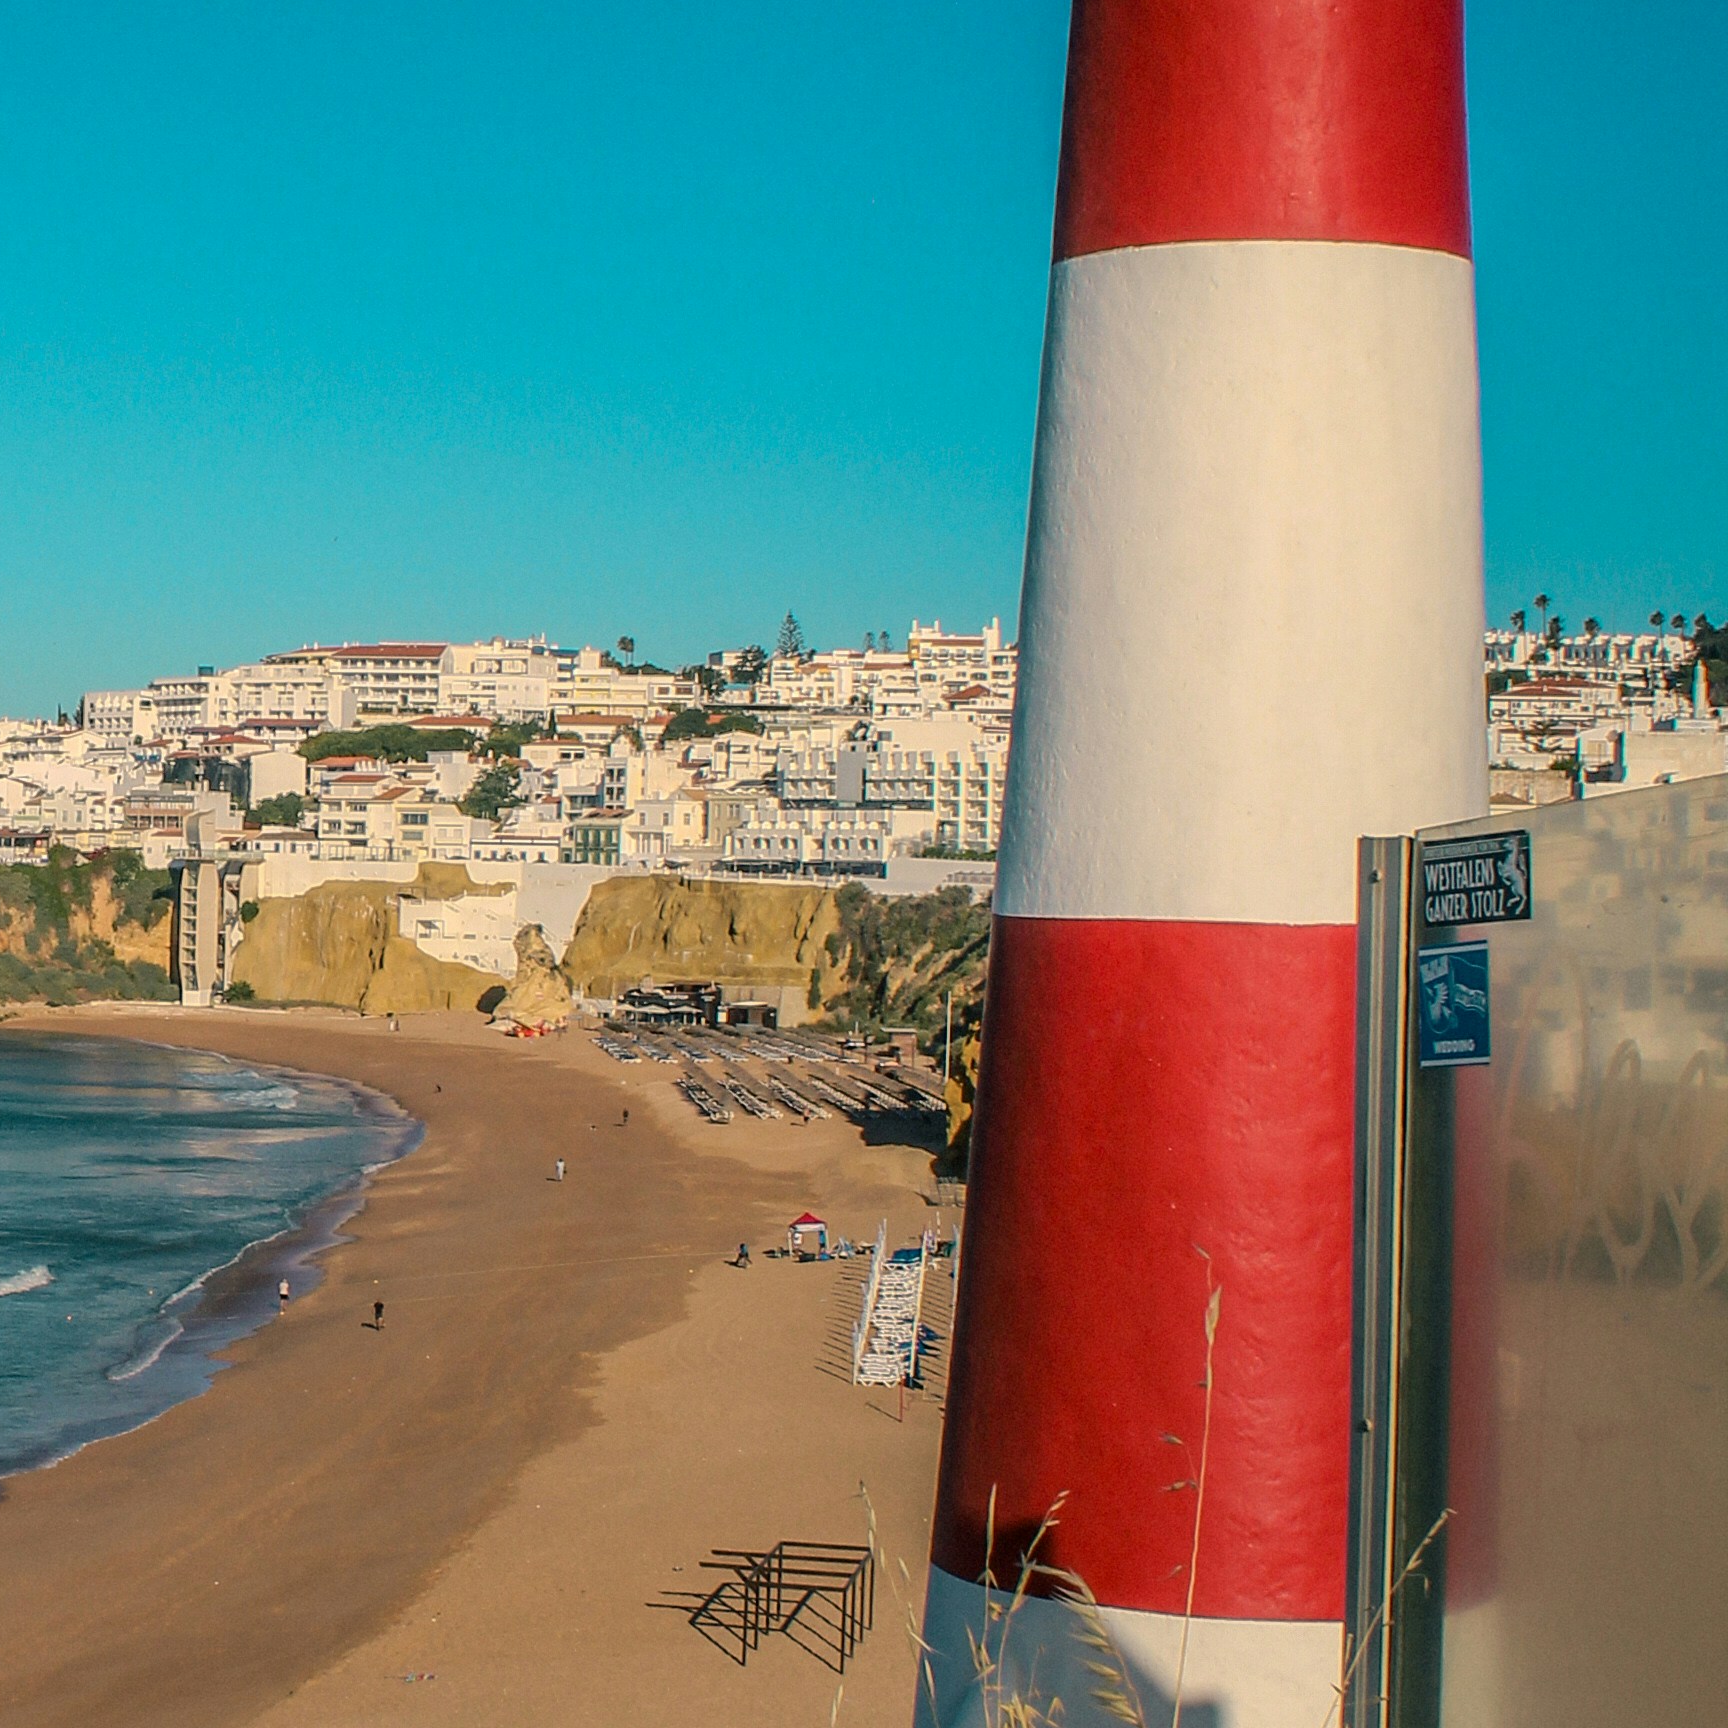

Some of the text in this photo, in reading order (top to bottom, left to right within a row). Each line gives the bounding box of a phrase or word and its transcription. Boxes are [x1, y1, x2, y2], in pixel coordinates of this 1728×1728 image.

[1425, 859, 1495, 892] WESTFALENS
[1426, 889, 1505, 922] GANZER STOLZ
[1433, 1039, 1475, 1054] WEDDING
